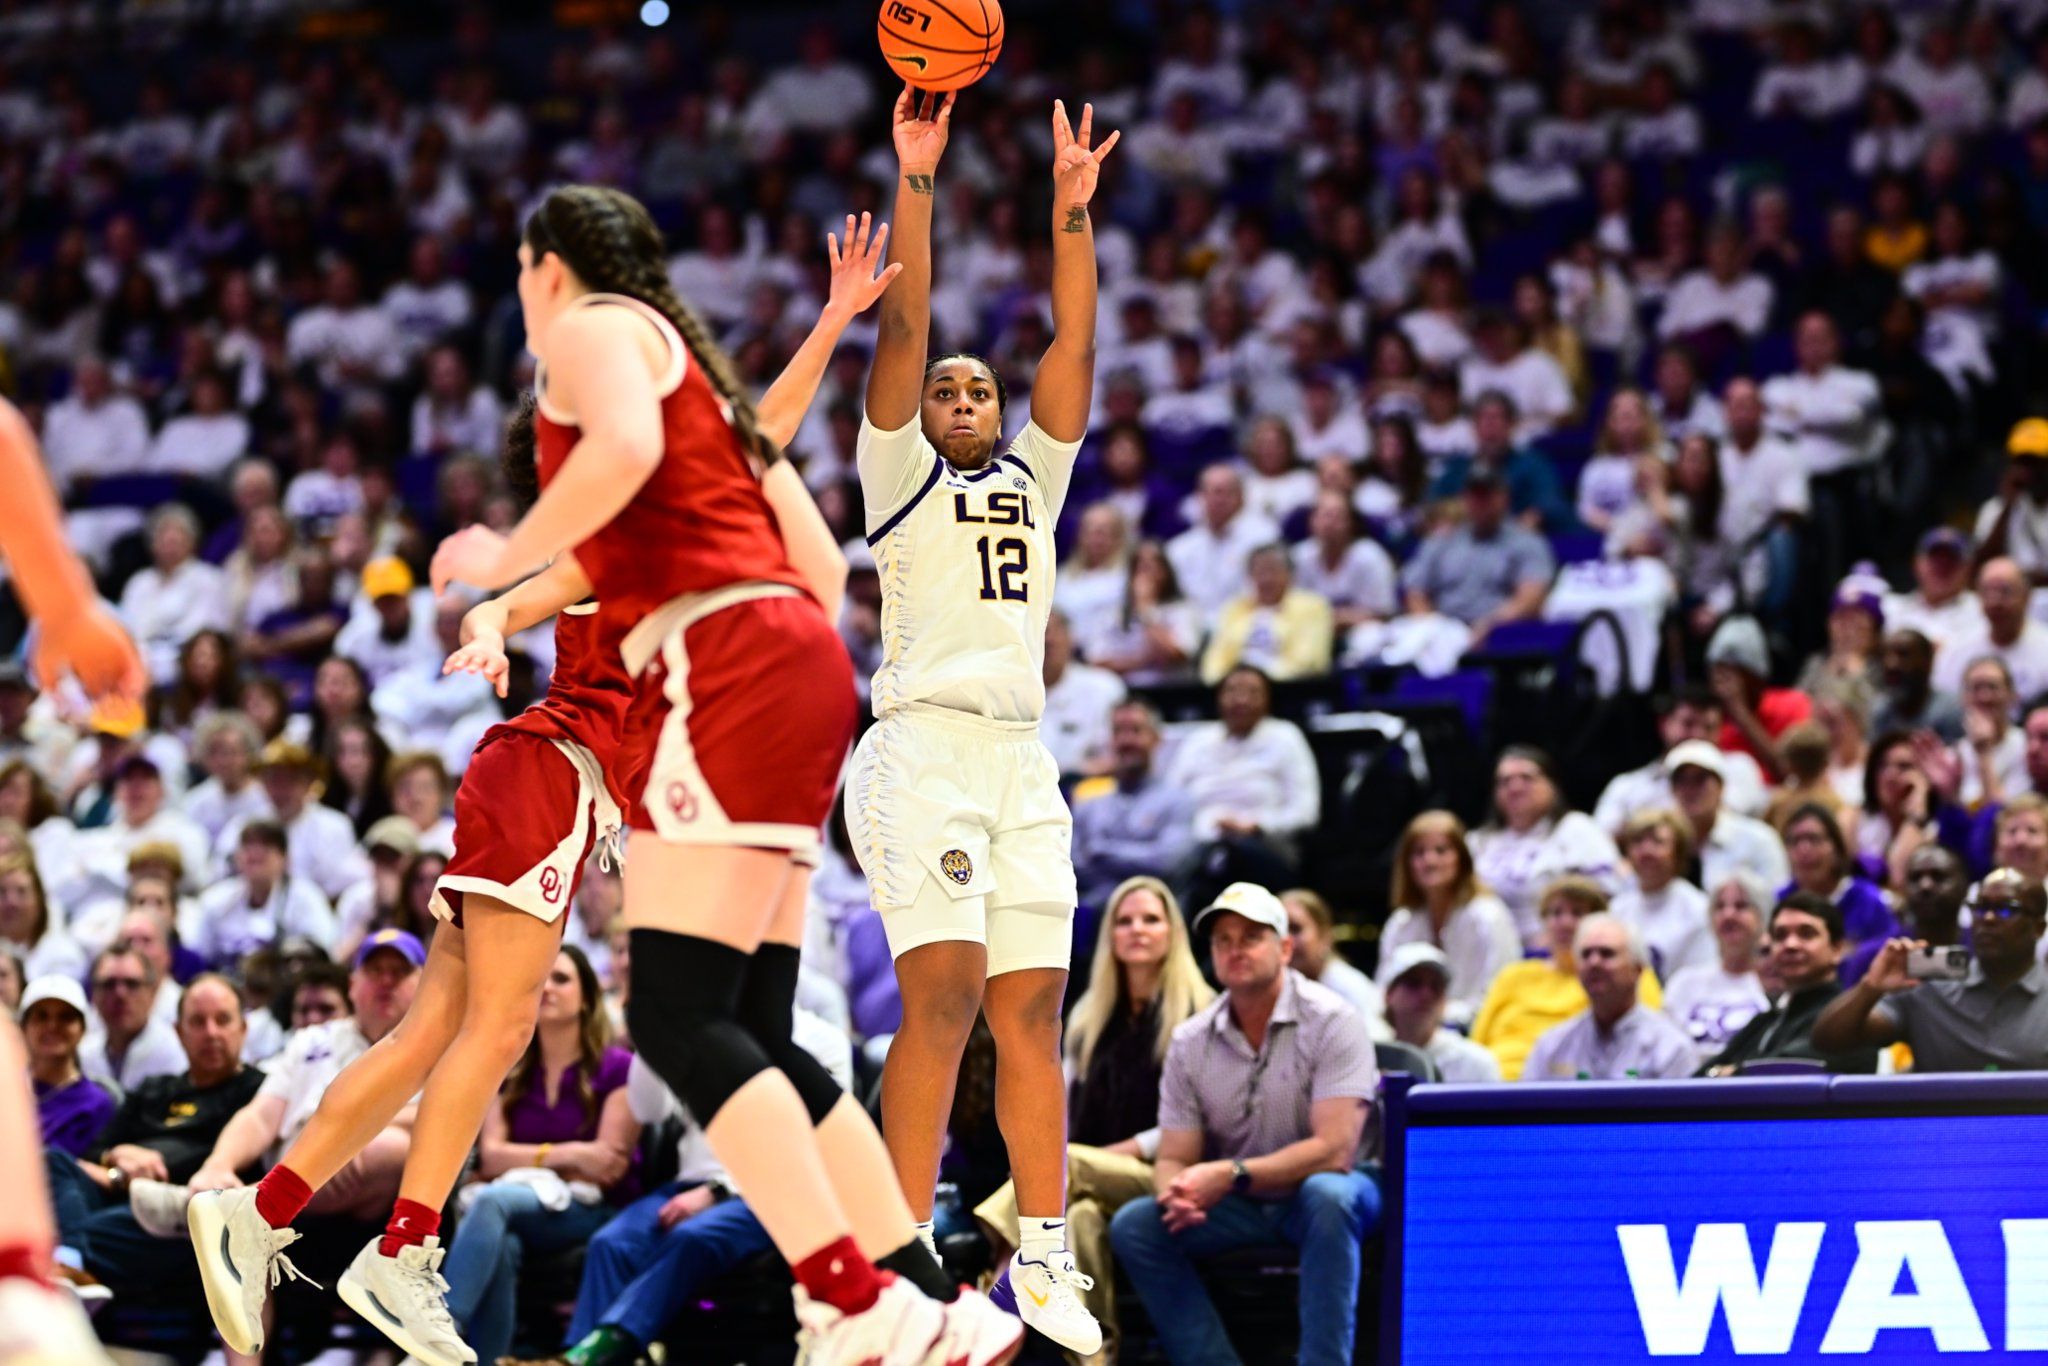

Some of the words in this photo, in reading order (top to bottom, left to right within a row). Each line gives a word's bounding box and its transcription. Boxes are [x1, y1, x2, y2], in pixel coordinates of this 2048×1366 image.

[887, 1, 931, 32] LSU
[977, 536, 1028, 602] 12
[539, 866, 562, 903] OU
